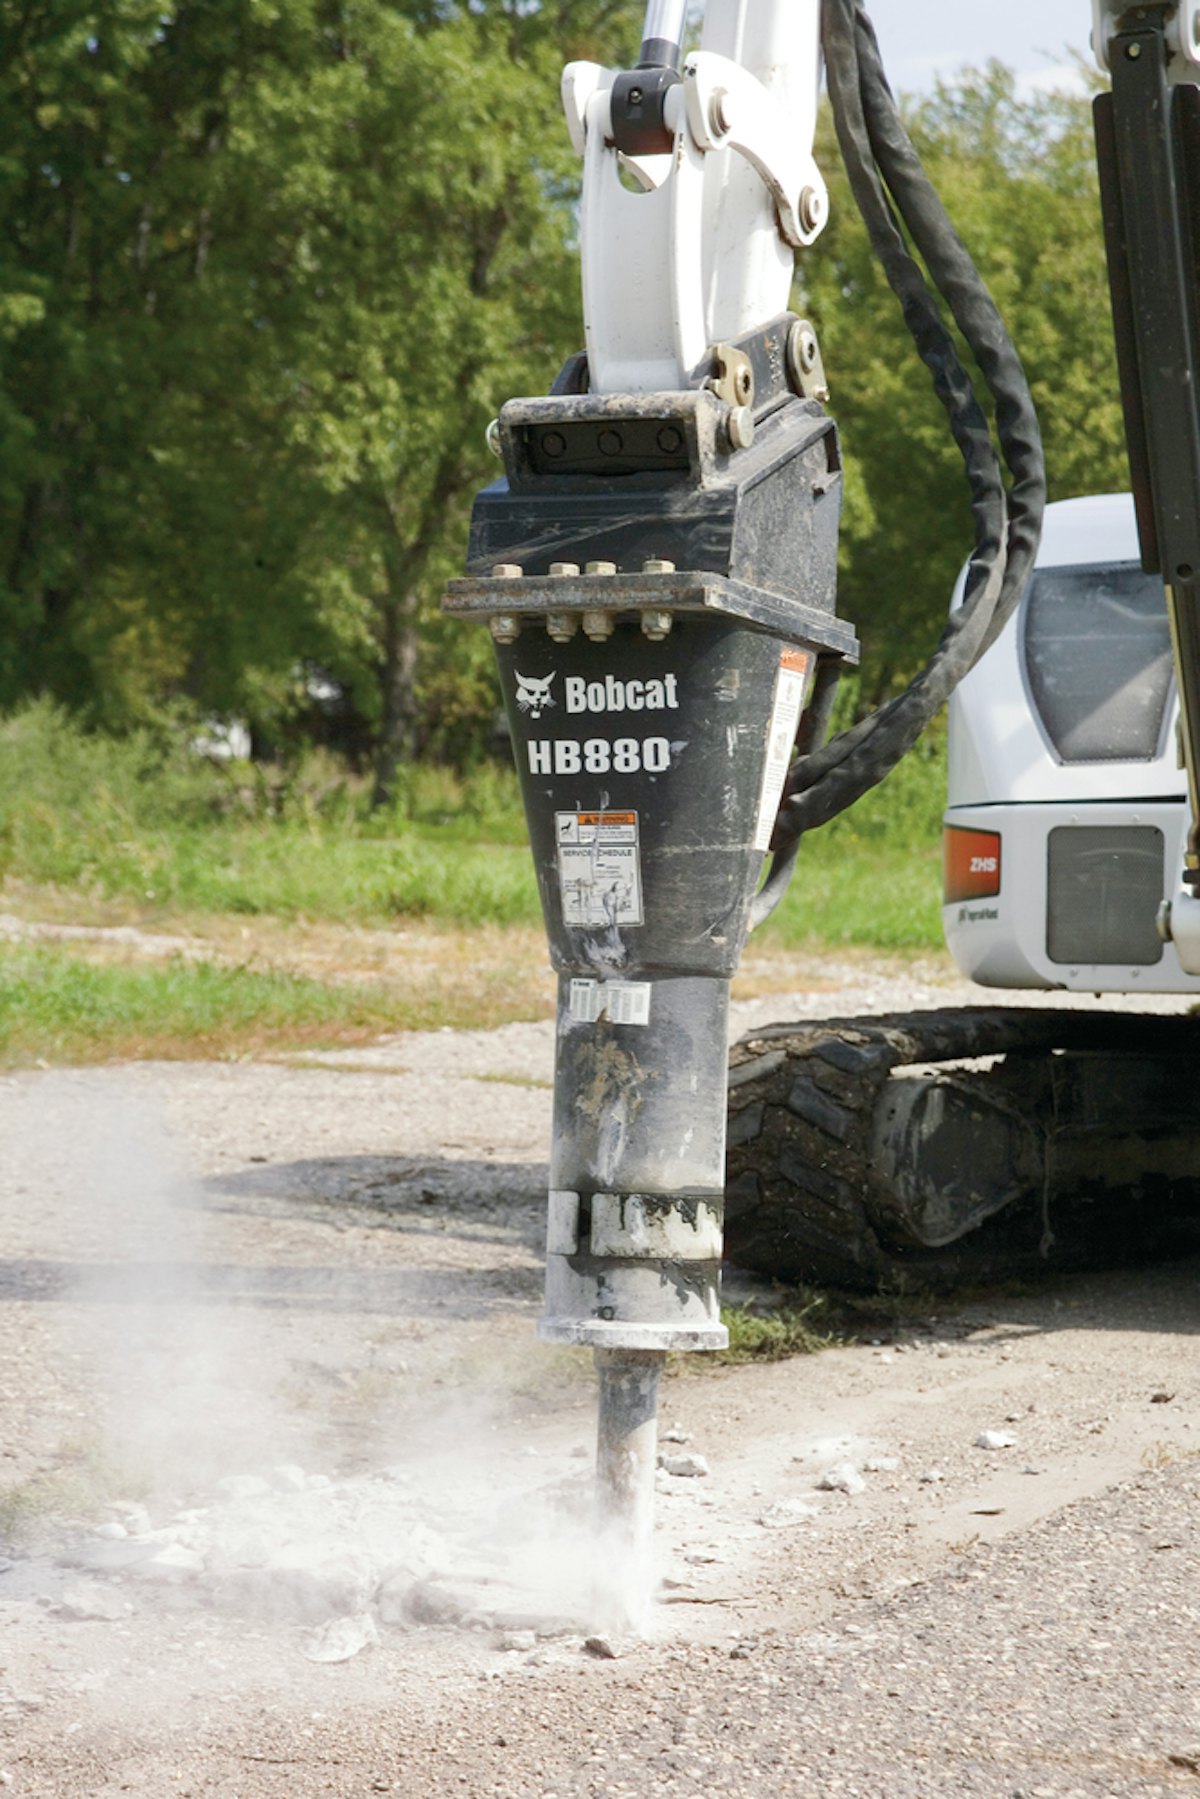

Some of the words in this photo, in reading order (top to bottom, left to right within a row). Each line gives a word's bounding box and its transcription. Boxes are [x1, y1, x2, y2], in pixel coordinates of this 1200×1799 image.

[565, 673, 679, 714] Bobcat
[527, 737, 671, 774] HB880
[594, 849, 632, 857] CHEDULE
[969, 857, 998, 872] ZHS
